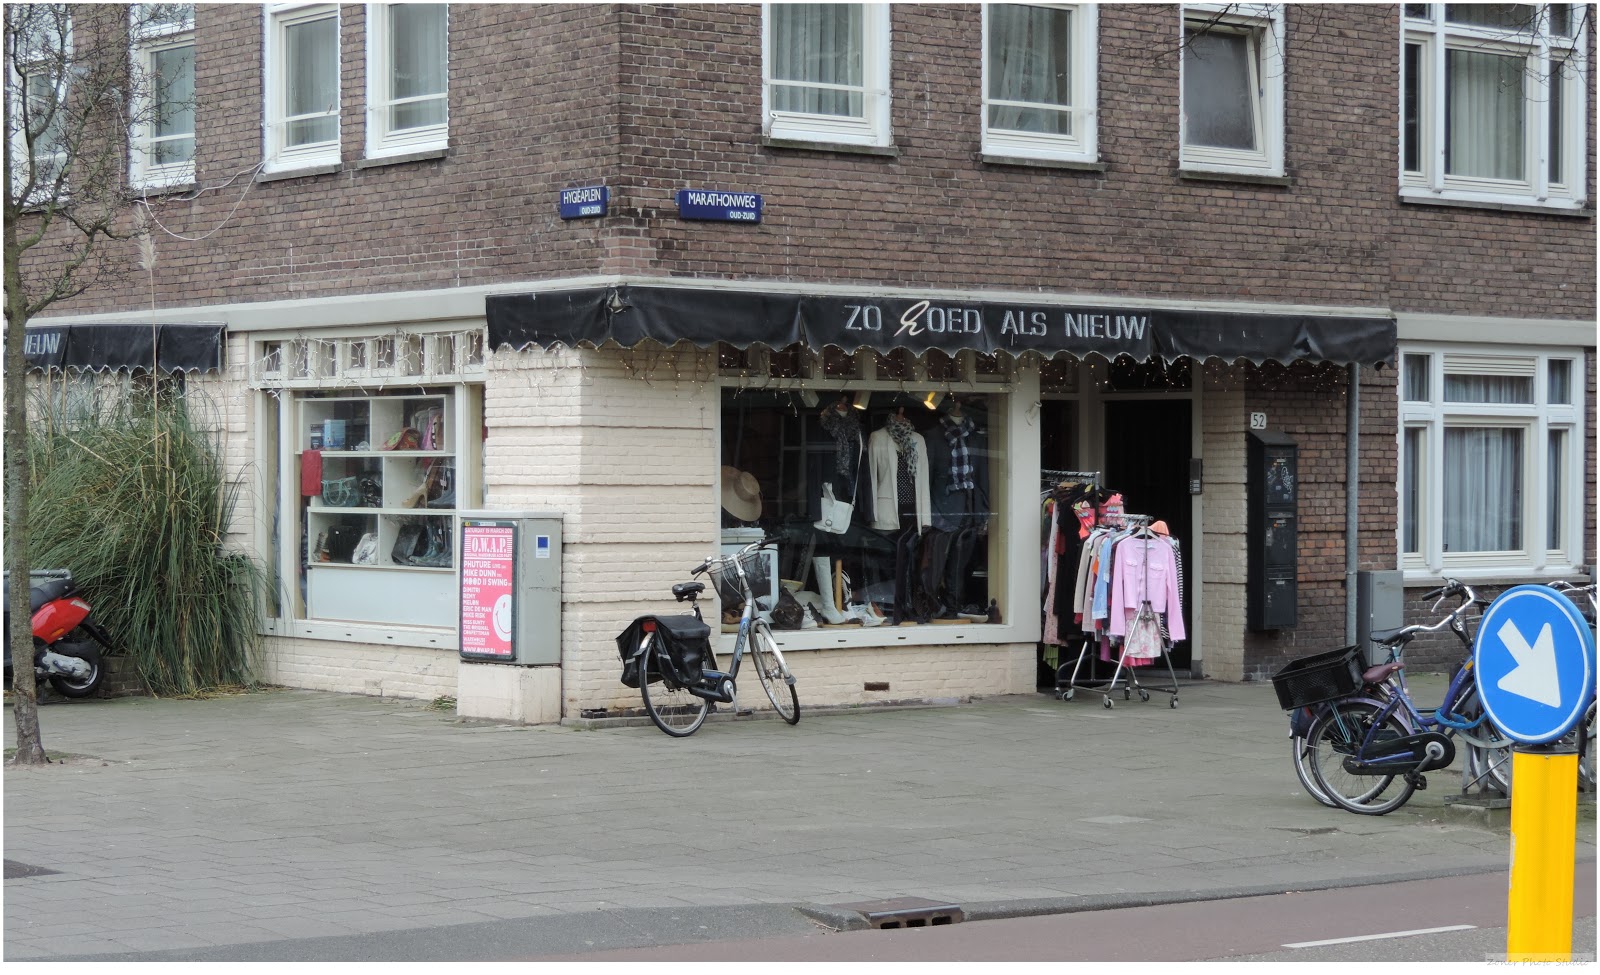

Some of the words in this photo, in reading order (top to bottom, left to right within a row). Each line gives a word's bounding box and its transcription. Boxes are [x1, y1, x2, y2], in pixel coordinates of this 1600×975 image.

[688, 192, 756, 208] MARATHONWEG
[581, 206, 601, 215] OUD-ZUID
[729, 211, 756, 220] OUD-ZUID
[844, 305, 882, 331] ZO
[1000, 310, 1048, 337] ALS
[1064, 312, 1147, 340] NIEUW
[24, 333, 61, 355] IEUW
[1252, 413, 1265, 427] 52
[471, 537, 507, 553] O.W.A.P.
[463, 561, 491, 569] PHUTURE
[479, 569, 497, 577] DUNN
[463, 577, 482, 585] MOOD
[488, 578, 508, 586] SWING
